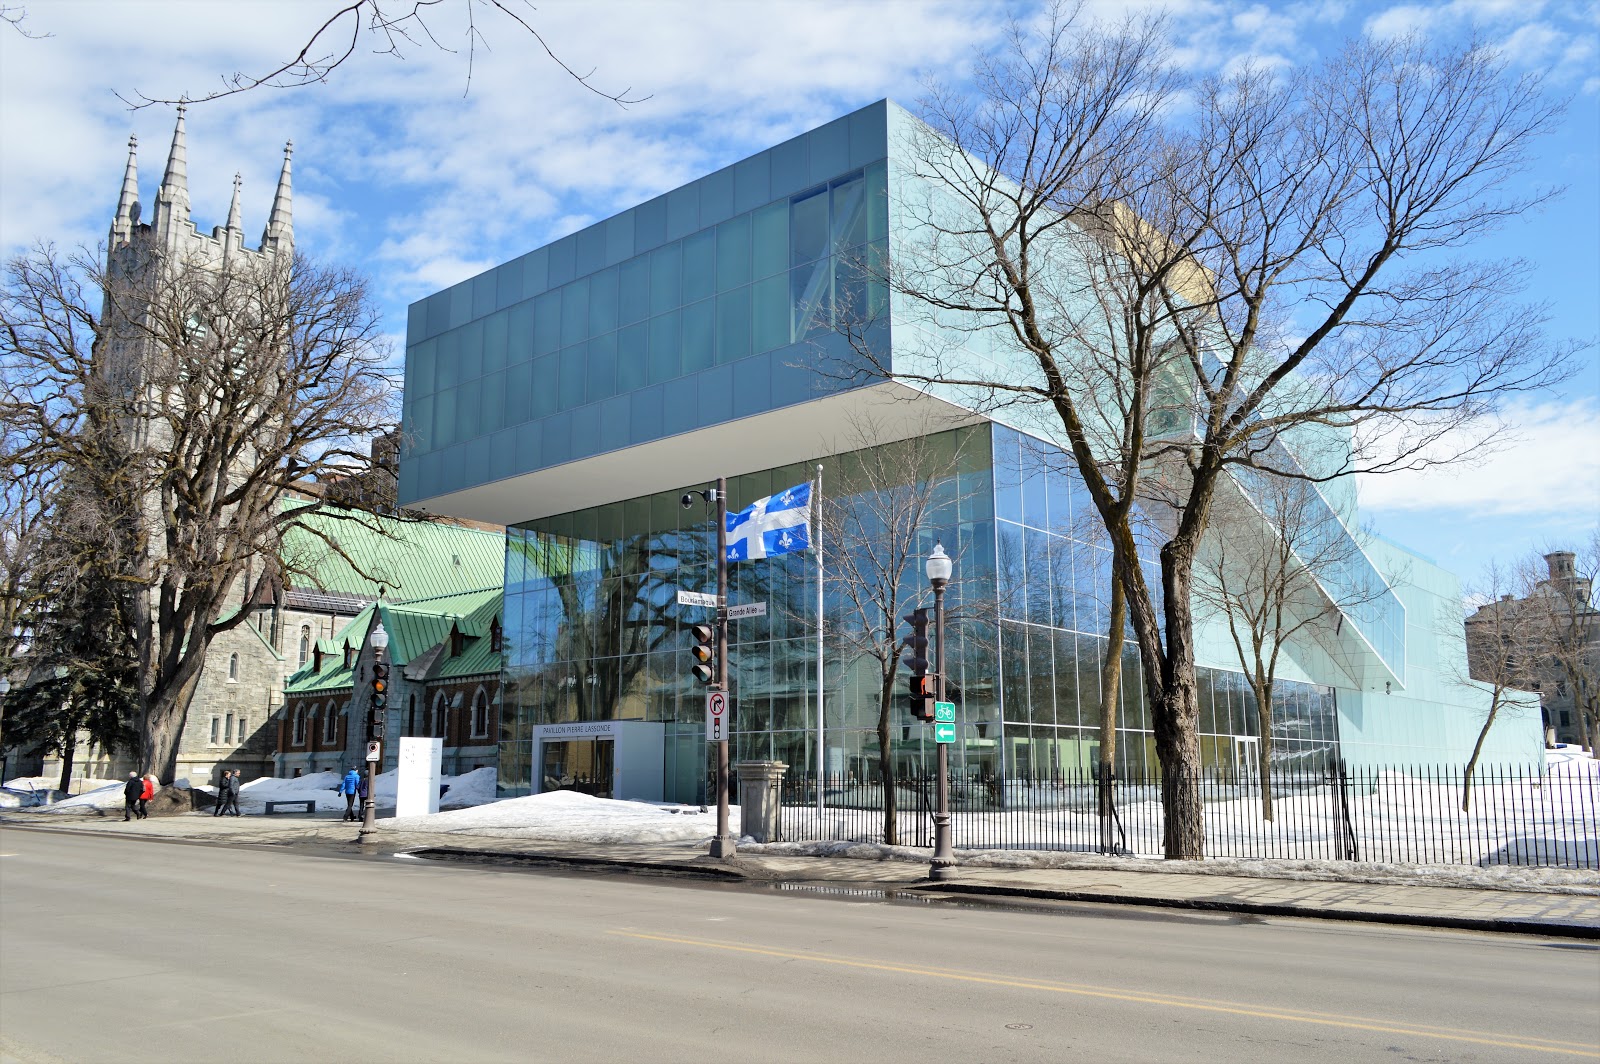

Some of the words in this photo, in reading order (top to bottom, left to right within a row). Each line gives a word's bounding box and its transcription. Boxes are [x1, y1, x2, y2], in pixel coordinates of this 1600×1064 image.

[729, 607, 745, 617] Grande
[543, 726, 565, 734] PAVILLON
[567, 725, 583, 733] PIERRE
[585, 724, 611, 733] LASSONDE
